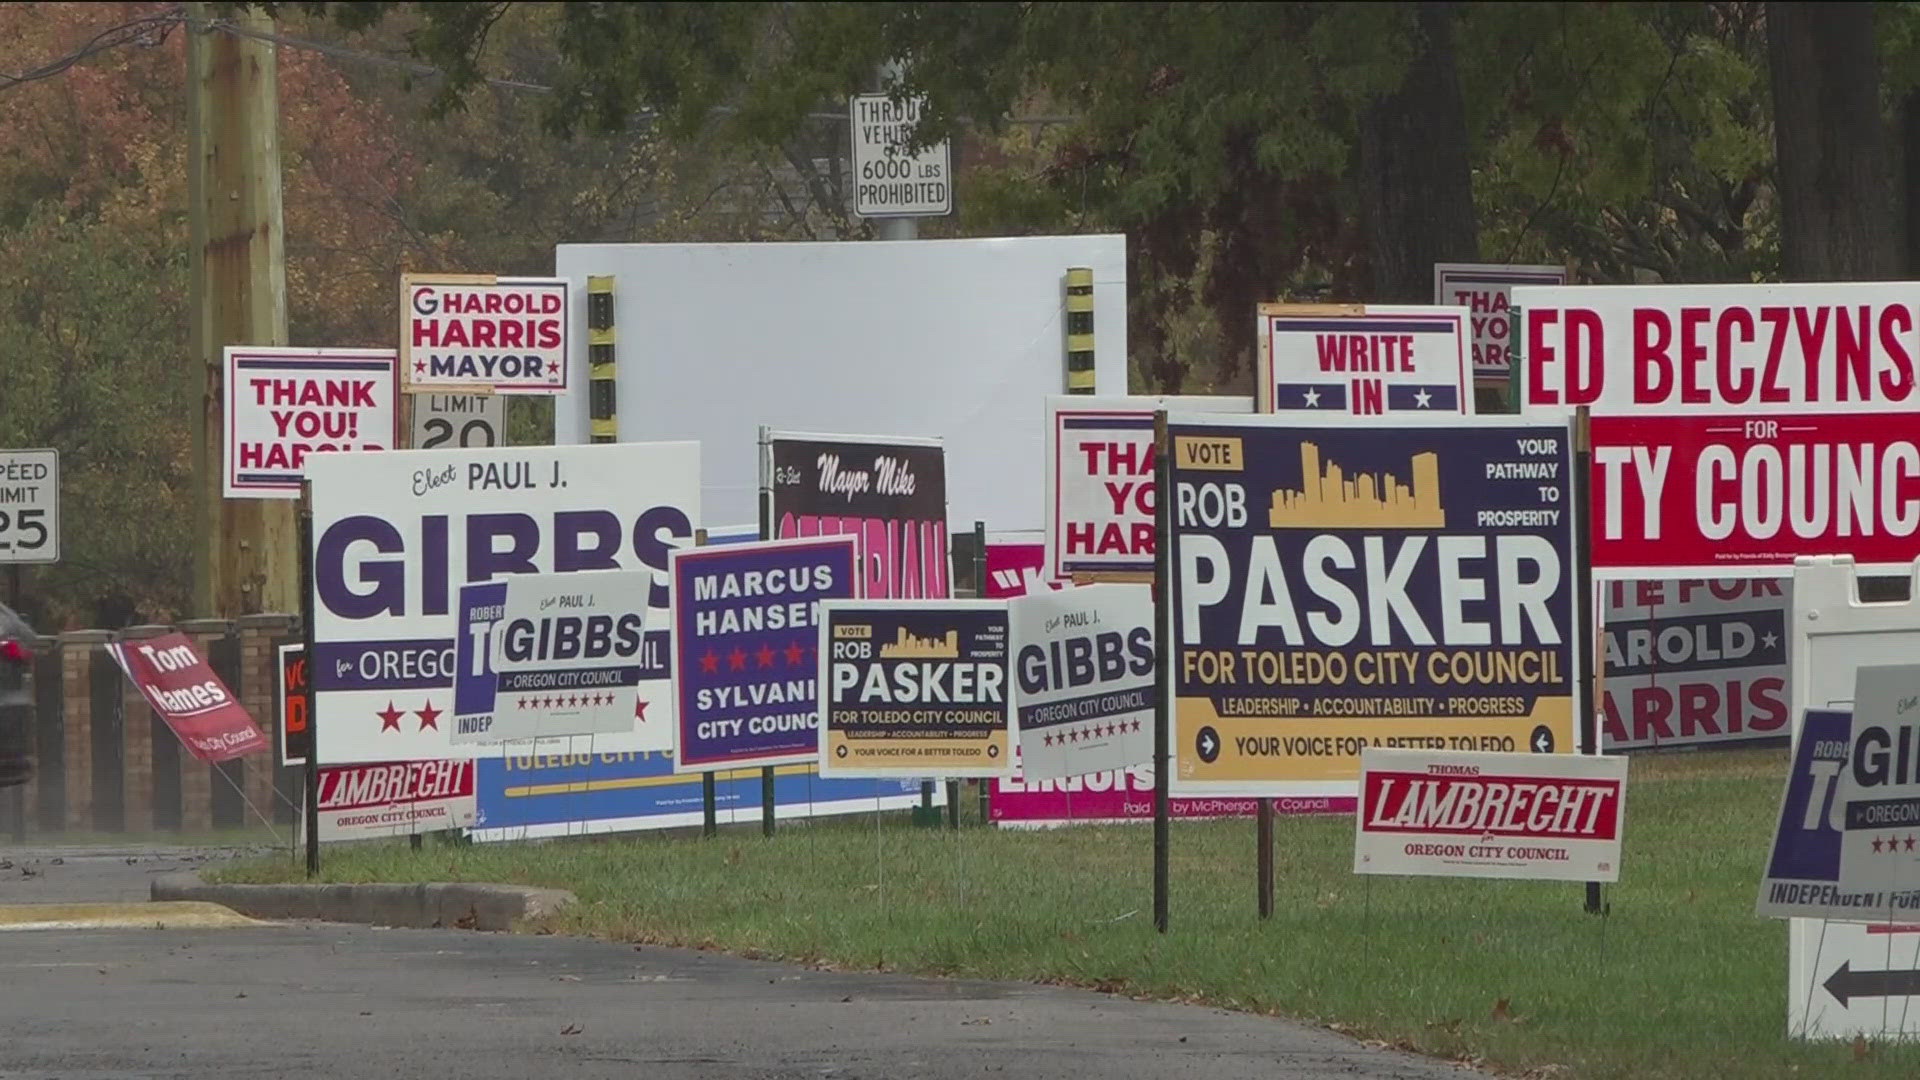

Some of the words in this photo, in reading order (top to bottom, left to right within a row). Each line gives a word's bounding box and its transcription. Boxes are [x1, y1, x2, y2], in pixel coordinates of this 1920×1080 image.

[860, 102, 919, 122] THROU
[863, 159, 911, 179] 6000
[918, 164, 941, 178] LBS
[859, 182, 945, 205] PROHIBITED
[443, 293, 561, 315] HAROLD
[412, 319, 561, 348] HARRIS
[1471, 317, 1508, 339] YO
[430, 354, 543, 378] MAYOR
[1316, 335, 1416, 373] WRITE
[1528, 308, 1605, 405] ED
[1633, 303, 1914, 405] BECZYNS
[250, 379, 377, 407] THANK
[431, 394, 489, 413] LIMIT
[1352, 379, 1383, 415] IN
[270, 411, 358, 439] YOU!
[421, 418, 495, 449] 20
[1745, 420, 1778, 438] FOR
[1187, 443, 1231, 464] VOTE
[1516, 439, 1558, 455] YOUR
[412, 464, 456, 496] Elect
[468, 461, 536, 490] PAUL
[550, 460, 567, 489] J.
[817, 452, 870, 502] Mayor
[874, 455, 916, 496] Mike
[1486, 463, 1559, 479] PATHWAY
[0, 487, 39, 503] IMIT
[1104, 482, 1156, 515] YO
[1178, 482, 1248, 528] ROB
[1539, 487, 1559, 502] TO
[1595, 445, 1672, 540] TY
[1695, 441, 1920, 541] COUNC
[1478, 511, 1560, 526] PROSPERITY
[1067, 522, 1156, 554] HAR
[316, 506, 693, 619] GIBBS
[694, 565, 833, 601] MARCUS
[1179, 534, 1562, 646] PASKER
[559, 595, 583, 608] PAUL
[588, 595, 595, 607] J.
[841, 627, 866, 636] VOTE
[1064, 612, 1090, 628] PAUL
[1093, 610, 1101, 623] J.
[505, 613, 642, 662] GIBBS
[833, 641, 872, 659] ROB
[1604, 622, 1755, 667] AROLD
[138, 645, 199, 673] Tom
[336, 658, 354, 677] for
[359, 650, 456, 680] OREGO
[1017, 626, 1155, 694] GIBBS
[1183, 650, 1236, 684] FOR
[1242, 651, 1348, 685] TOLEDO
[1354, 651, 1420, 684] CITY
[1428, 650, 1563, 684] COUNCIL
[513, 673, 556, 687] OREGON
[558, 672, 580, 686] CITY
[581, 670, 623, 685] COUNCIL
[833, 662, 1004, 703] PASKER
[146, 681, 226, 712] Names
[697, 679, 815, 710] SYLVANI
[1035, 705, 1077, 723] OREGON
[1079, 699, 1101, 716] CITY
[1101, 692, 1145, 712] COUNCIL
[1222, 698, 1300, 715] LEADERSHIP
[1313, 698, 1435, 715] ACCOUNTABILITY
[1449, 697, 1525, 714] PROGRESS
[833, 711, 858, 723] FOR
[862, 711, 911, 723] TOLEDO
[913, 711, 944, 723] CITY
[945, 711, 1003, 723] COUNCIL
[1601, 677, 1788, 742] ARRIS
[697, 719, 743, 740] CITY
[749, 712, 819, 734] COUNC
[854, 748, 874, 756] YOUR
[877, 748, 900, 756] VOICE
[901, 748, 916, 756] FOR
[917, 748, 923, 756] A
[924, 748, 951, 756] BETTER
[953, 748, 981, 756] TOLEDO
[1236, 738, 1280, 756] YOUR
[1285, 737, 1333, 756] VOICE
[1449, 735, 1515, 752] TOLEDO
[316, 760, 471, 808] LAMBRECHT
[1428, 764, 1480, 776] THOMAS
[337, 814, 379, 826] OREGON
[381, 811, 404, 823] CITY
[406, 807, 447, 820] COUNCIL
[1124, 802, 1150, 814] Paid
[1173, 802, 1189, 813] by
[1281, 798, 1329, 810] Council
[1368, 779, 1615, 834] LAMBRECHT
[1866, 805, 1919, 824] OREGON
[1404, 843, 1465, 857] OREGON
[1469, 845, 1504, 859] CITY
[1507, 847, 1569, 861] COUNCIL
